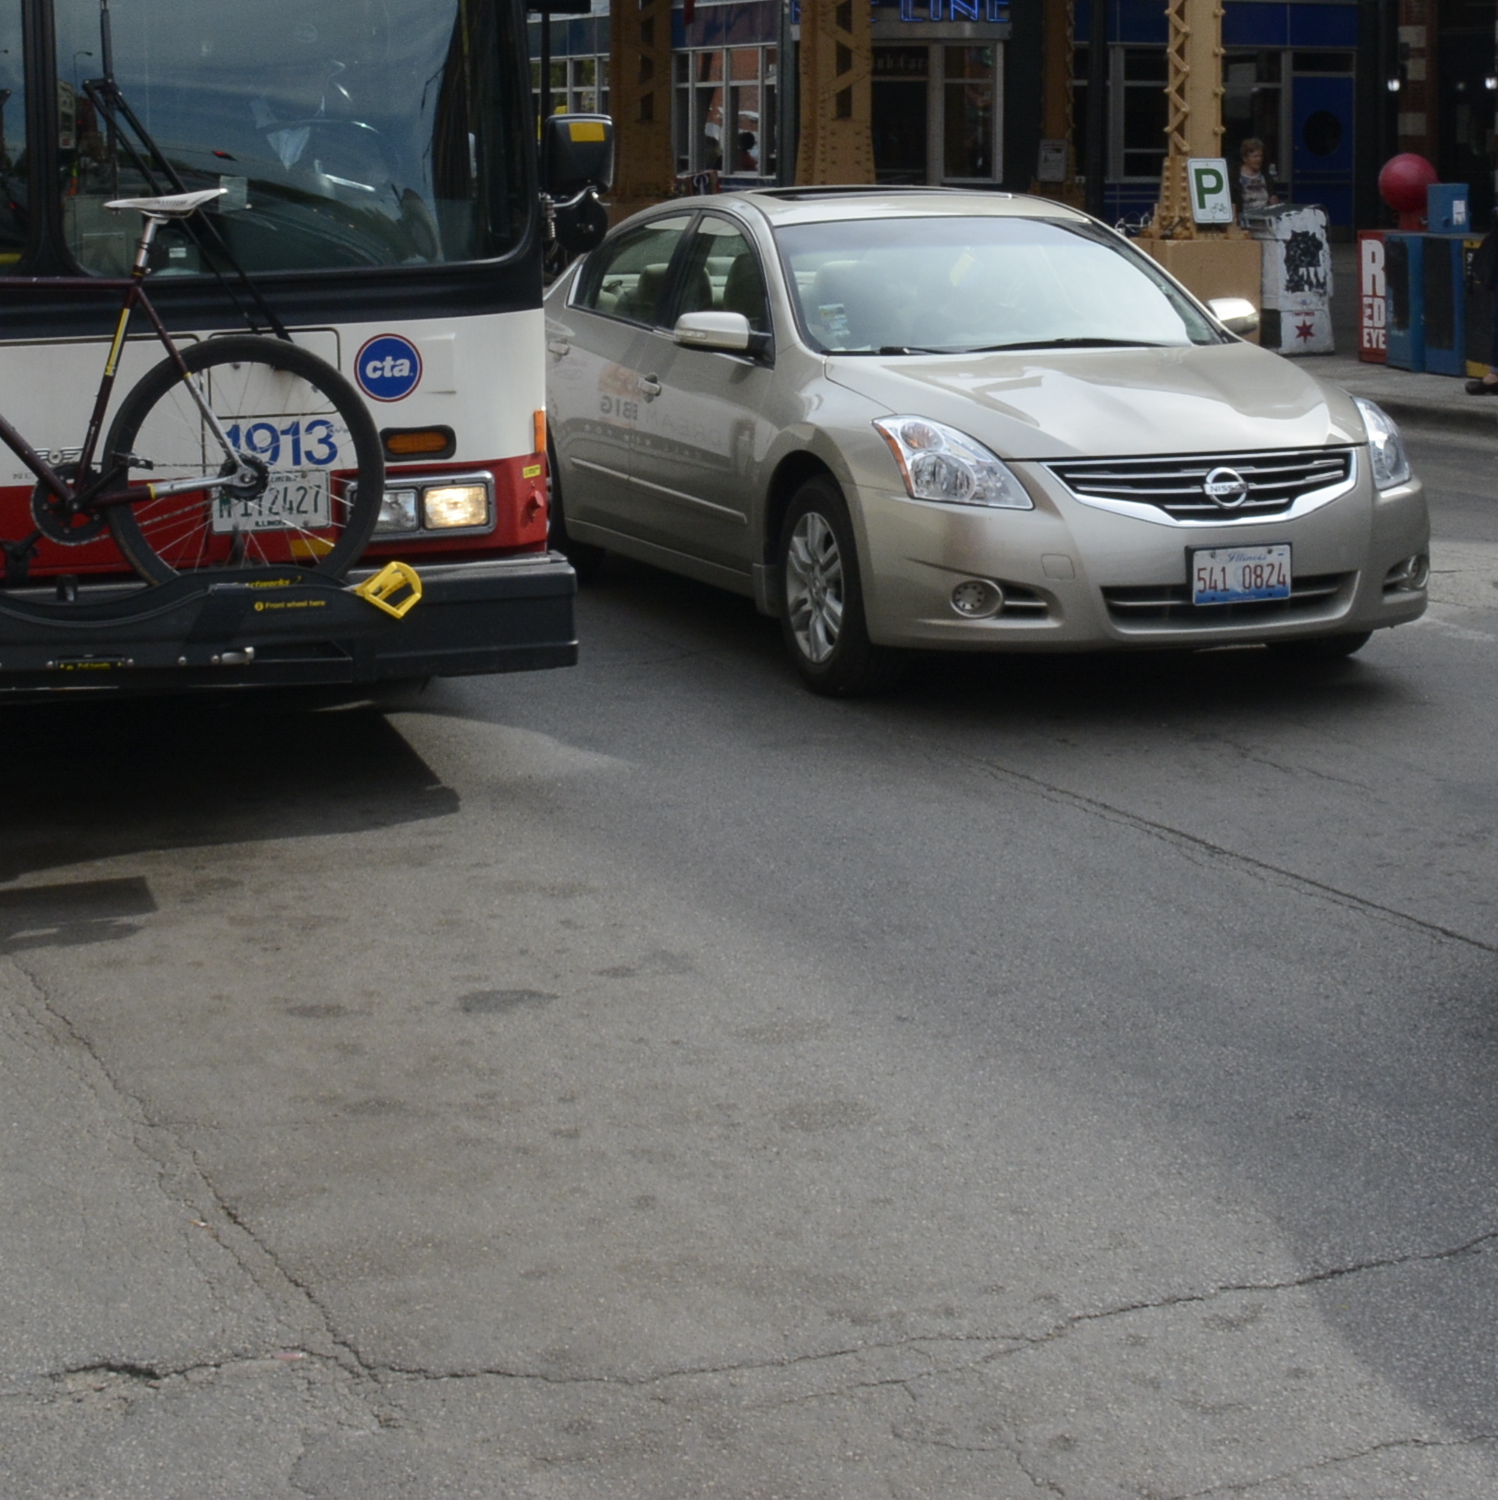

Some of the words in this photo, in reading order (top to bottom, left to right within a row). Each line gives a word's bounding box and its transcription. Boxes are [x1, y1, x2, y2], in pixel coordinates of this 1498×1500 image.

[1193, 168, 1224, 211] P
[1363, 329, 1387, 349] EYE
[365, 355, 411, 379] cta
[225, 419, 338, 468] 1913
[1210, 483, 1247, 493] NISSAN
[1227, 552, 1268, 564] Illinois
[1197, 566, 1230, 593] 541
[1242, 562, 1287, 591] 0824
